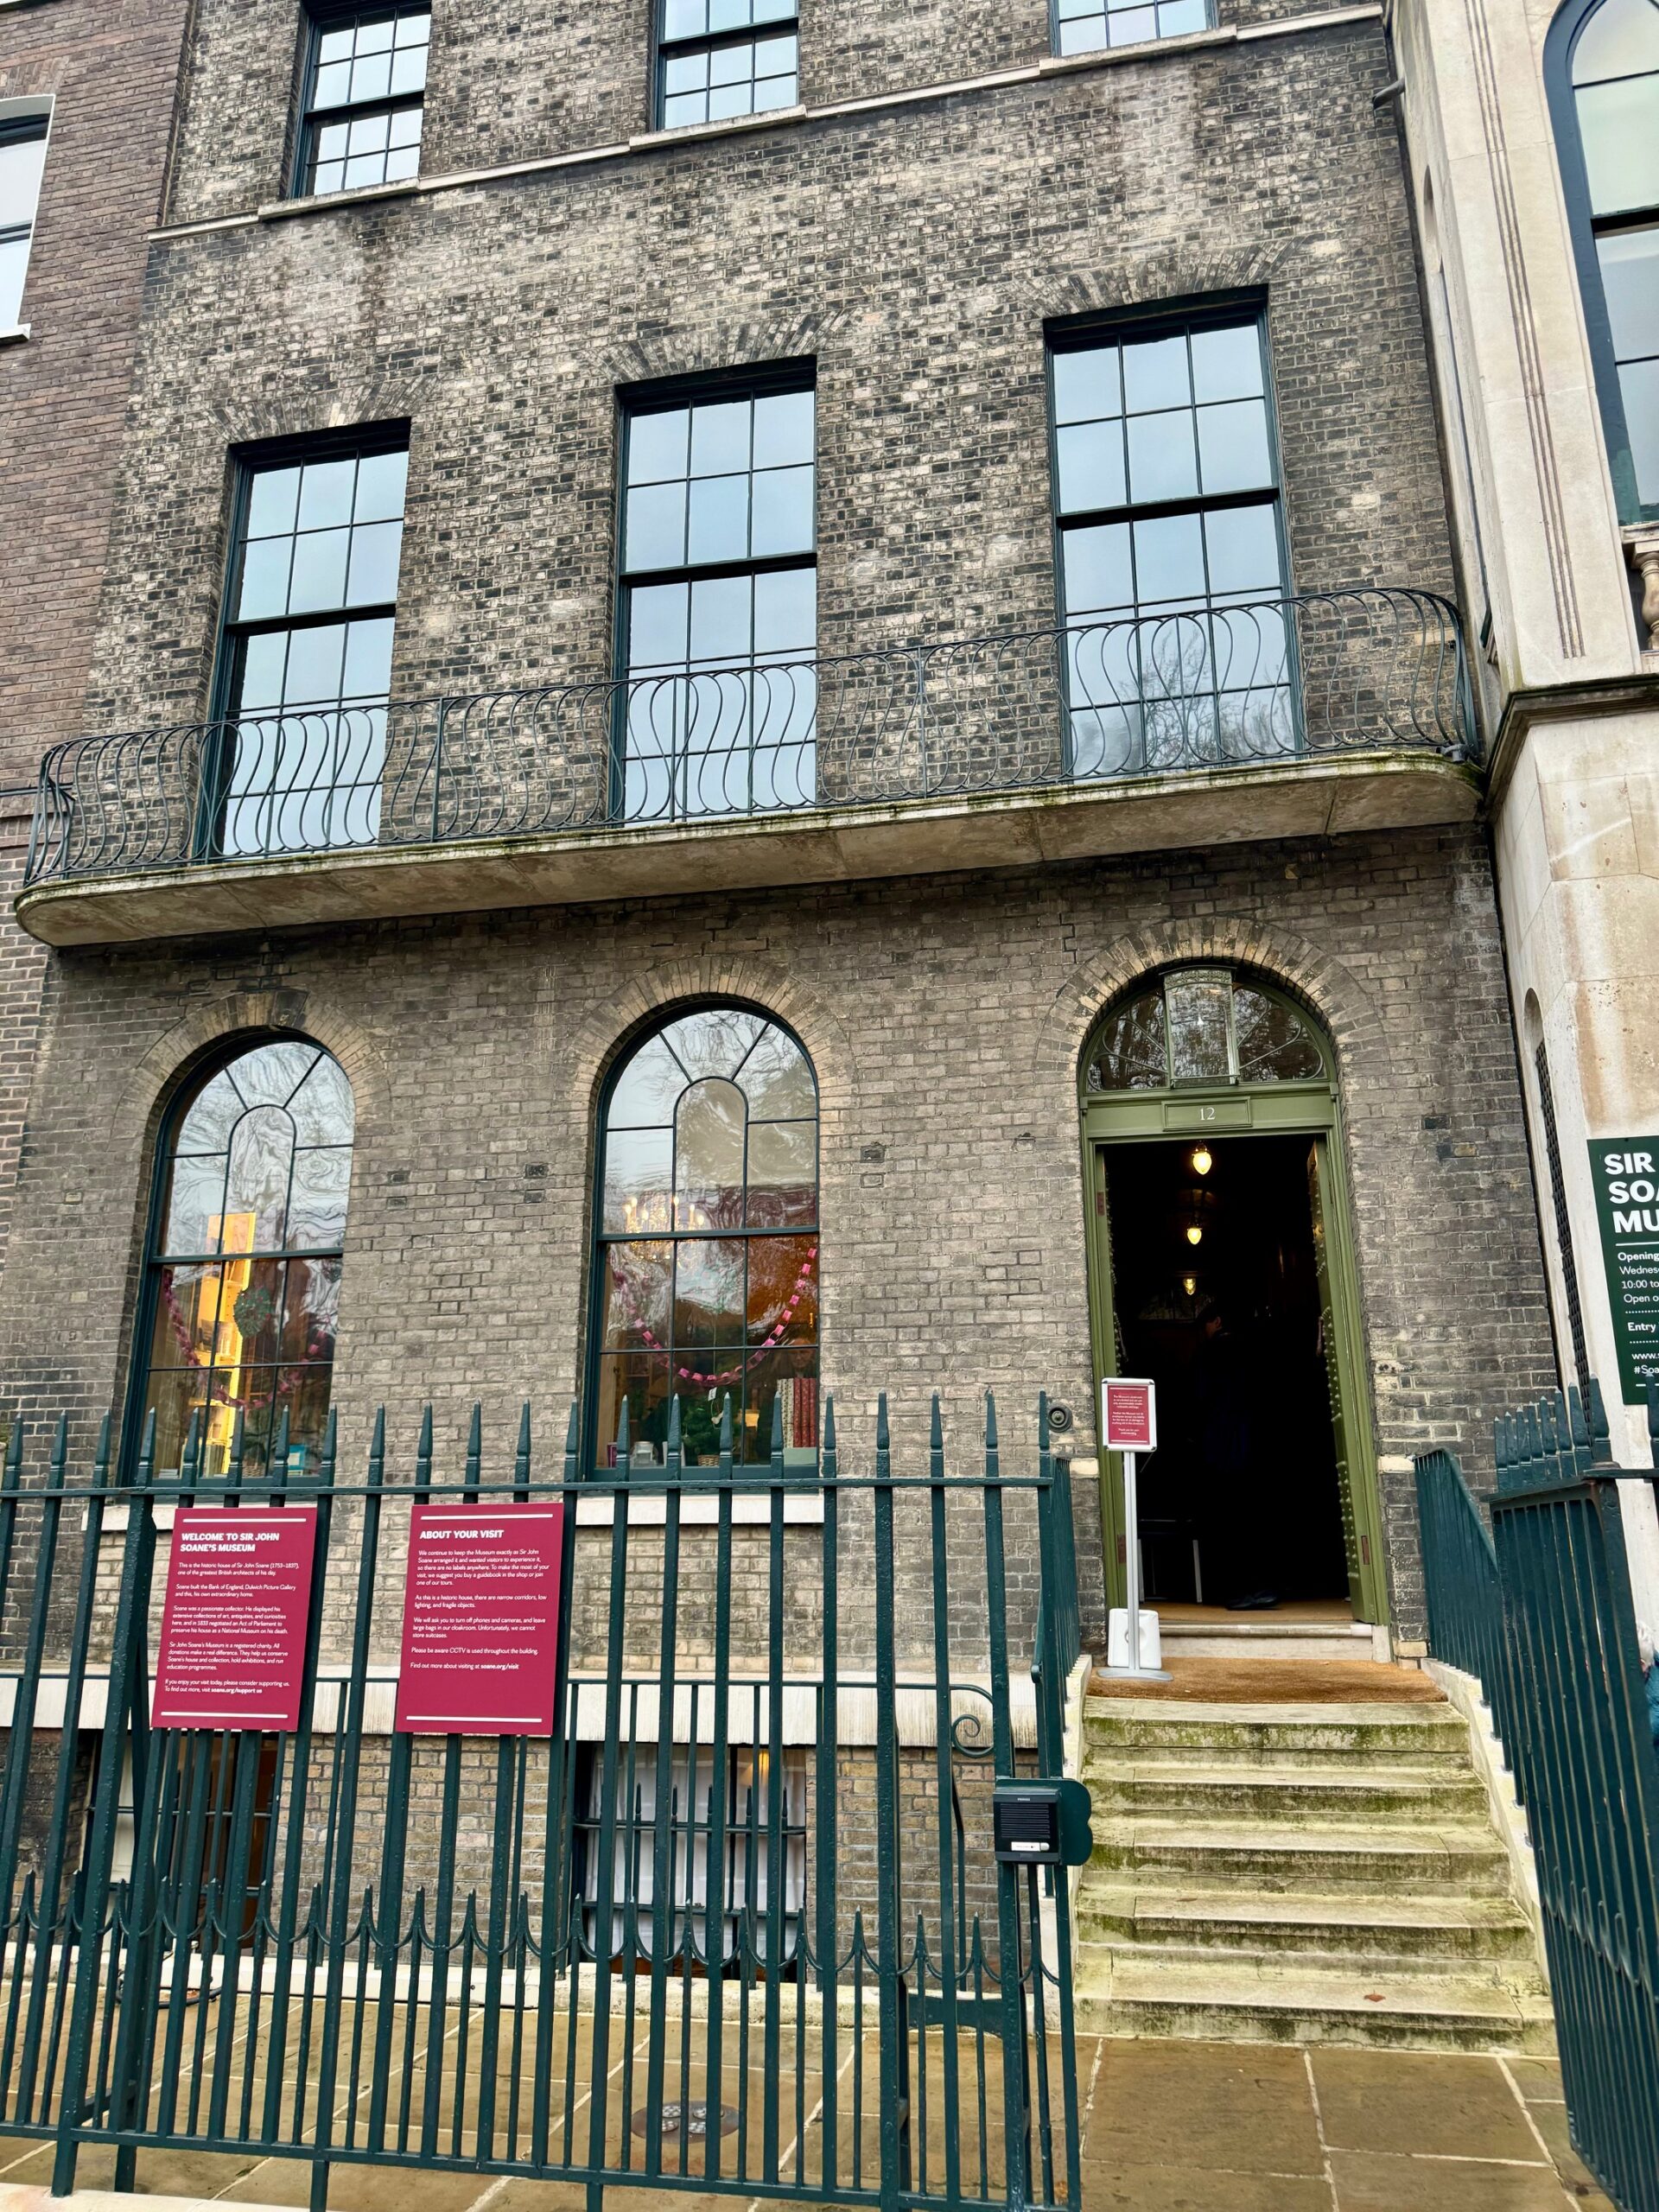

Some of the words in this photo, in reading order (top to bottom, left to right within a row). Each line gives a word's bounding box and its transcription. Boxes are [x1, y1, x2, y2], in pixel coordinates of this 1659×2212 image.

[1200, 1107, 1215, 1120] 12
[1604, 1152, 1656, 1175] SIR
[1608, 1179, 1659, 1205] SO
[1618, 1265, 1659, 1275] Wednes
[1621, 1280, 1648, 1289] 10:00
[1624, 1294, 1650, 1305] Open
[1627, 1322, 1656, 1333] Entry
[420, 1530, 451, 1539] ABOUT
[454, 1530, 478, 1539] YOUR
[480, 1529, 504, 1538] VISIT
